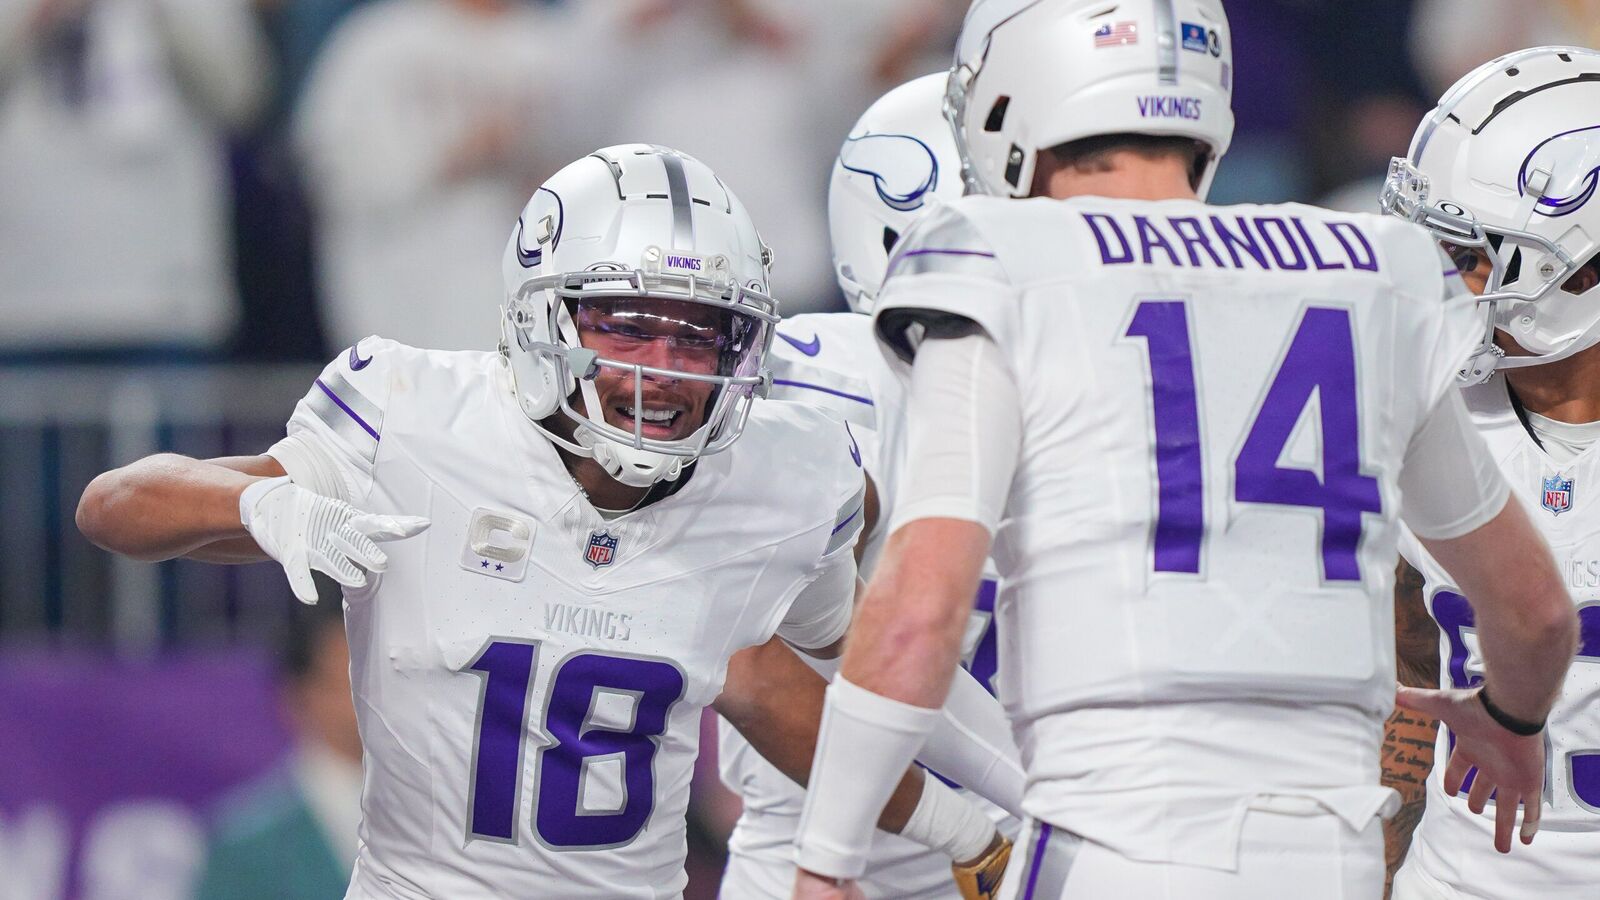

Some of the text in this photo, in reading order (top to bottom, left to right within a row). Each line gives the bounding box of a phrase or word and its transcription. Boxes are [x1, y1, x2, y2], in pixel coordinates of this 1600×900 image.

[1137, 96, 1202, 120] VIKINGS
[1081, 212, 1379, 272] DARNOLD
[667, 255, 702, 271] VIKINGS
[1117, 296, 1385, 587] 14
[1546, 490, 1568, 508] NFL
[588, 545, 610, 563] NFL
[545, 602, 632, 641] VIKINGS
[459, 635, 688, 852] 18
